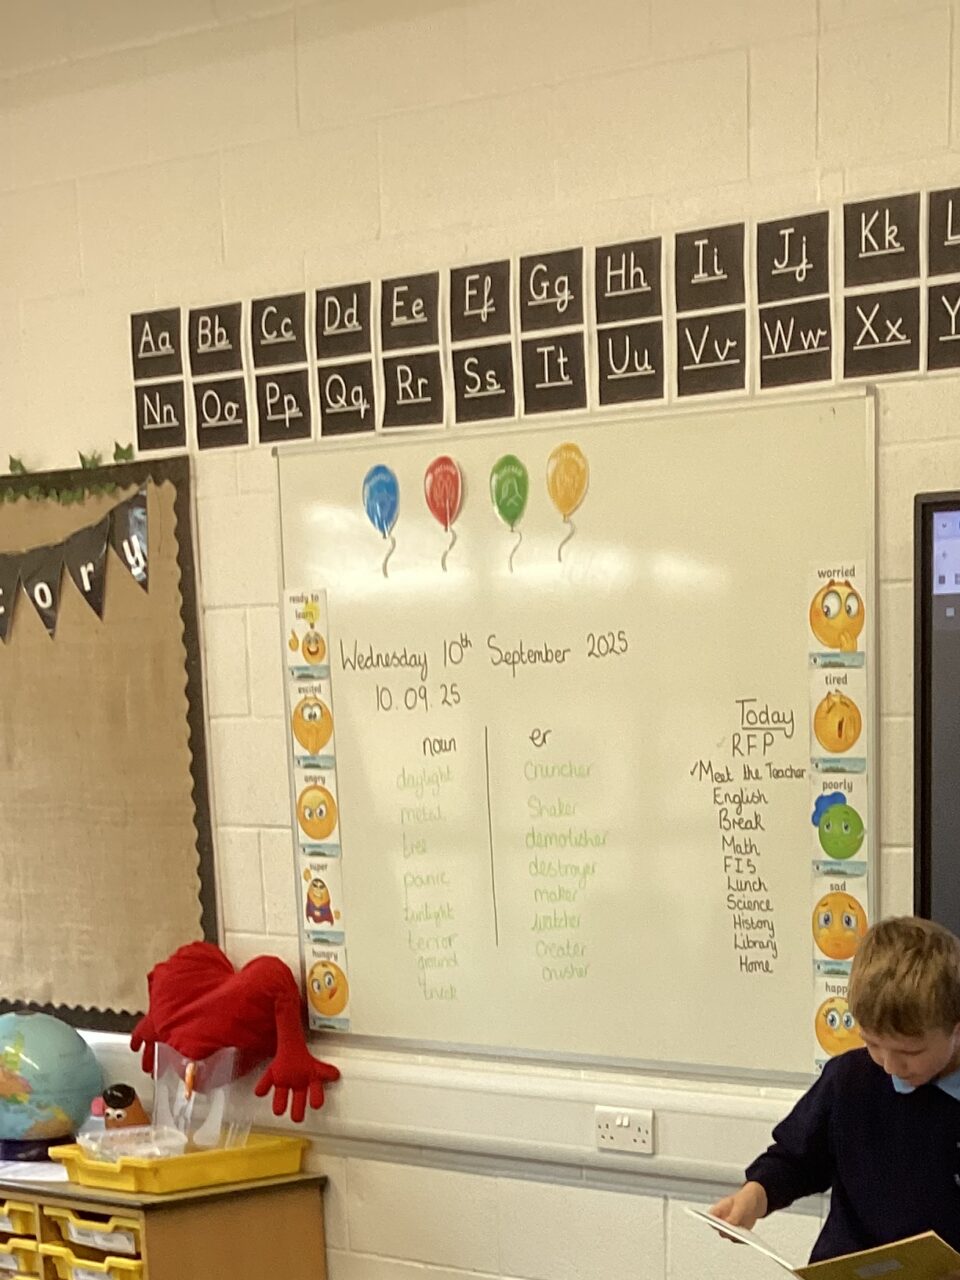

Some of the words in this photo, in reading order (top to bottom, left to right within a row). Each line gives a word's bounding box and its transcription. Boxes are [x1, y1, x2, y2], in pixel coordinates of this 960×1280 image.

[139, 321, 174, 355] Aa
[197, 315, 232, 350] Bb
[260, 307, 296, 343] Cc
[323, 296, 361, 334] Dd
[391, 286, 427, 325] Ee
[464, 274, 495, 322] Ff
[528, 264, 573, 312] Gg
[605, 253, 650, 295] Hh
[692, 239, 727, 282] Ii
[772, 228, 813, 281] Jj
[859, 210, 905, 257] Kk
[143, 397, 178, 428] Nn
[202, 390, 242, 426] Oo
[267, 382, 302, 427] Pp
[325, 374, 370, 417] Qq
[396, 365, 431, 403] Rr
[464, 358, 505, 397] Ss
[535, 345, 572, 387] Tt
[607, 336, 655, 378] Uu
[683, 325, 740, 369] Vv
[762, 318, 829, 359] Ww
[853, 303, 911, 350] Xx
[817, 566, 856, 578] worried
[340, 638, 428, 681] Wednesday
[443, 634, 472, 666] 10th
[487, 634, 571, 678] September
[587, 630, 629, 657] 2025
[825, 674, 848, 685] tired
[735, 698, 795, 738] Today
[422, 736, 457, 757] noun
[529, 728, 552, 747] er
[732, 732, 775, 757] RFP
[397, 765, 453, 798] daylight
[699, 760, 734, 784] Meet
[743, 764, 762, 779] the
[764, 762, 808, 779] Teacher
[822, 779, 853, 792] poorly
[713, 788, 769, 815] English
[719, 808, 765, 831] Break
[722, 835, 760, 855] Math
[727, 876, 768, 892] Lunch
[830, 881, 847, 891] sad
[727, 894, 773, 912] Science
[733, 913, 775, 938] History
[312, 949, 338, 961] hungry
[734, 930, 778, 959] Library
[740, 956, 774, 973] Home
[825, 982, 848, 994] happ
